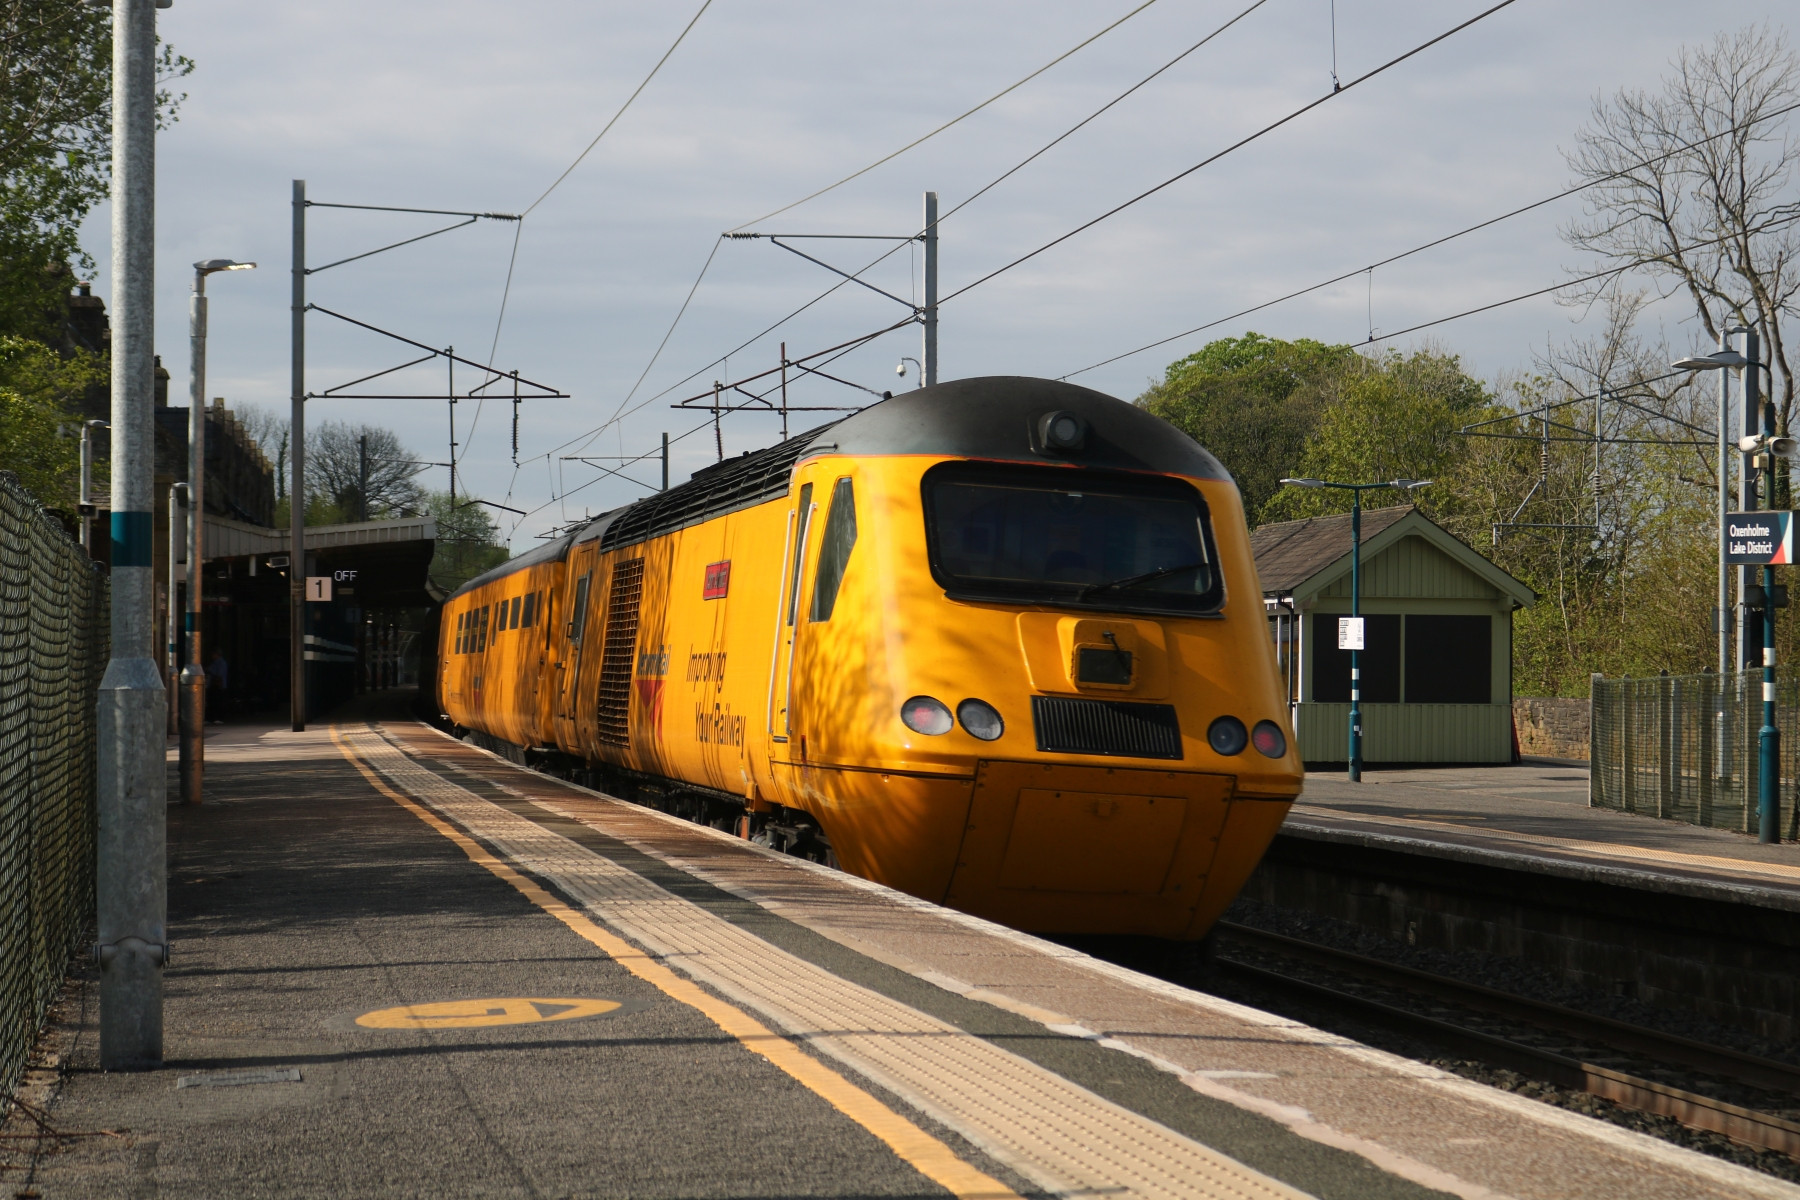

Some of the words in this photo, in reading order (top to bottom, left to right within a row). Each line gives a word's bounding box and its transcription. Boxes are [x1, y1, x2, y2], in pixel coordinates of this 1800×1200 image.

[1730, 524, 1770, 537] Oxenholme
[1730, 541, 1746, 554] Lake
[1747, 541, 1772, 554] District
[334, 570, 358, 581] OFF
[316, 580, 322, 598] 1
[686, 641, 727, 694] Improving
[695, 701, 713, 743] Your
[713, 702, 747, 759] Railway
